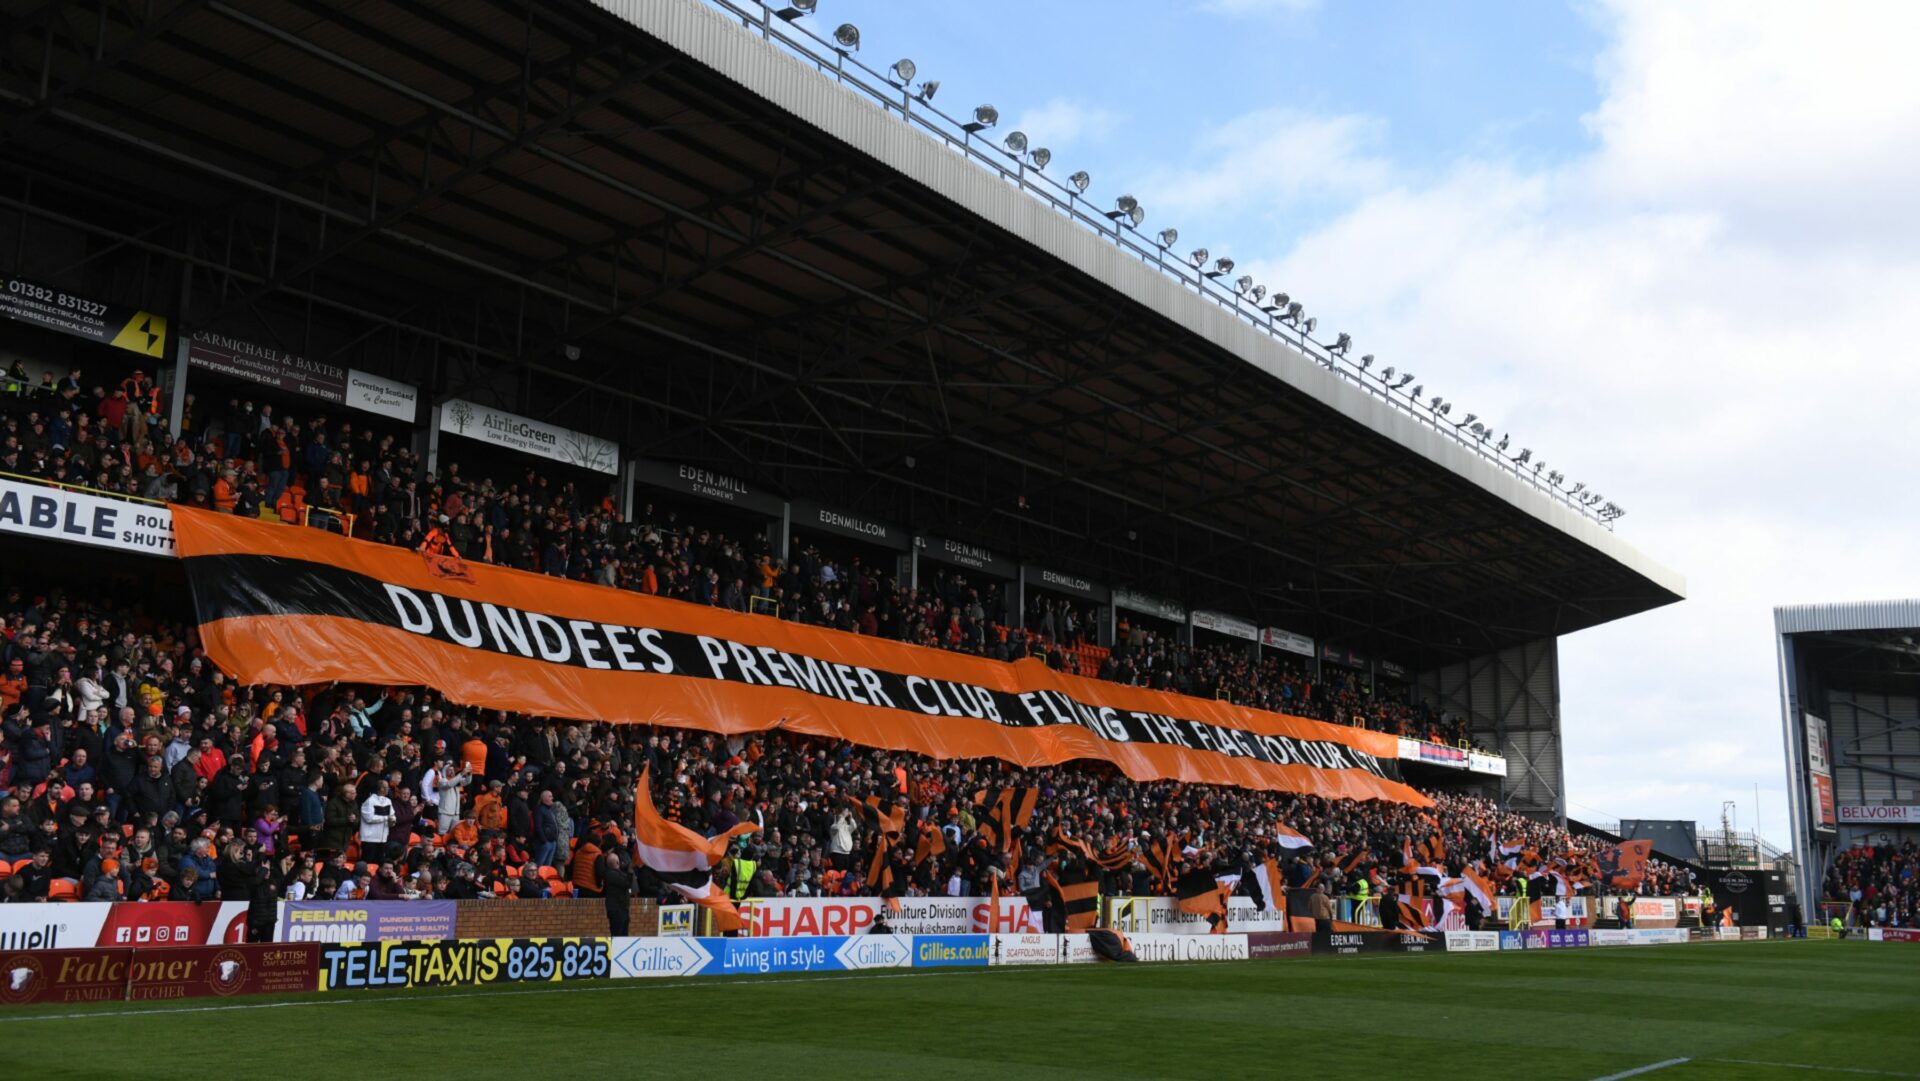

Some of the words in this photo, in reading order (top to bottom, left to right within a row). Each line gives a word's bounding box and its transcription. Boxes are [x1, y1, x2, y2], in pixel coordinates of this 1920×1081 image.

[9, 280, 53, 302] 01382
[58, 293, 108, 316] 831327
[193, 332, 279, 362] CARMICHAEL
[283, 354, 292, 365] &
[296, 357, 344, 380] BAXTER
[233, 355, 280, 375] Groundworks
[190, 356, 281, 386] www.groundworking.co.uk
[352, 379, 384, 395] Covering
[385, 386, 414, 401] Scotland
[483, 414, 556, 445] AirlieGreen
[487, 430, 501, 442] Low
[502, 434, 527, 448] Energy
[528, 439, 551, 453] Homes
[679, 464, 748, 494] EDEN.MILL
[692, 483, 701, 492] ST
[702, 485, 734, 500] ANDREWS
[0, 490, 118, 540] ABLE
[820, 510, 886, 538] EDENMILL.COM
[122, 531, 176, 550] SHUTT
[945, 539, 992, 562] EDEN.MILL
[962, 556, 983, 568] ANDREWS
[1043, 570, 1091, 592] EDENMILL.COM
[382, 583, 674, 674] DUNDEE'S
[697, 635, 896, 708] PREMIER
[1018, 690, 1129, 742] FLYNG
[1130, 711, 1193, 749] THE
[1189, 720, 1256, 758] FLAG
[1253, 735, 1308, 765] FOR
[1299, 739, 1354, 769] OUR
[290, 909, 368, 923] FEELING
[379, 916, 420, 924] DUNDEE'S
[421, 915, 450, 923] YOUTH
[663, 910, 690, 927] MKM
[739, 904, 875, 936] SHARP
[929, 904, 967, 919] Division
[972, 903, 1031, 934] SHA
[1151, 908, 1180, 924] OFFICIAL
[1229, 908, 1236, 922] OF
[1237, 908, 1261, 922] DUNDEE
[378, 925, 414, 933] MENTAL
[415, 924, 450, 932] HEALTH
[919, 941, 989, 961] Gillies.co.uk
[1021, 936, 1041, 945] ANGUS
[1128, 938, 1180, 960] entral
[1187, 938, 1244, 960] Coaches
[1330, 934, 1364, 946] EDEN.MILL
[507, 946, 554, 979] 825
[563, 944, 607, 977] 825
[632, 947, 683, 972] Gillies
[723, 946, 769, 973] Living
[773, 947, 787, 965] in
[790, 945, 825, 968] style
[857, 944, 897, 965] Gillies
[1006, 947, 1044, 957] SCAFFOLDING
[1045, 947, 1056, 956] LTD
[57, 954, 198, 984] Falconer
[64, 987, 113, 1001] FAMILY
[120, 985, 185, 1000] UTCHER
